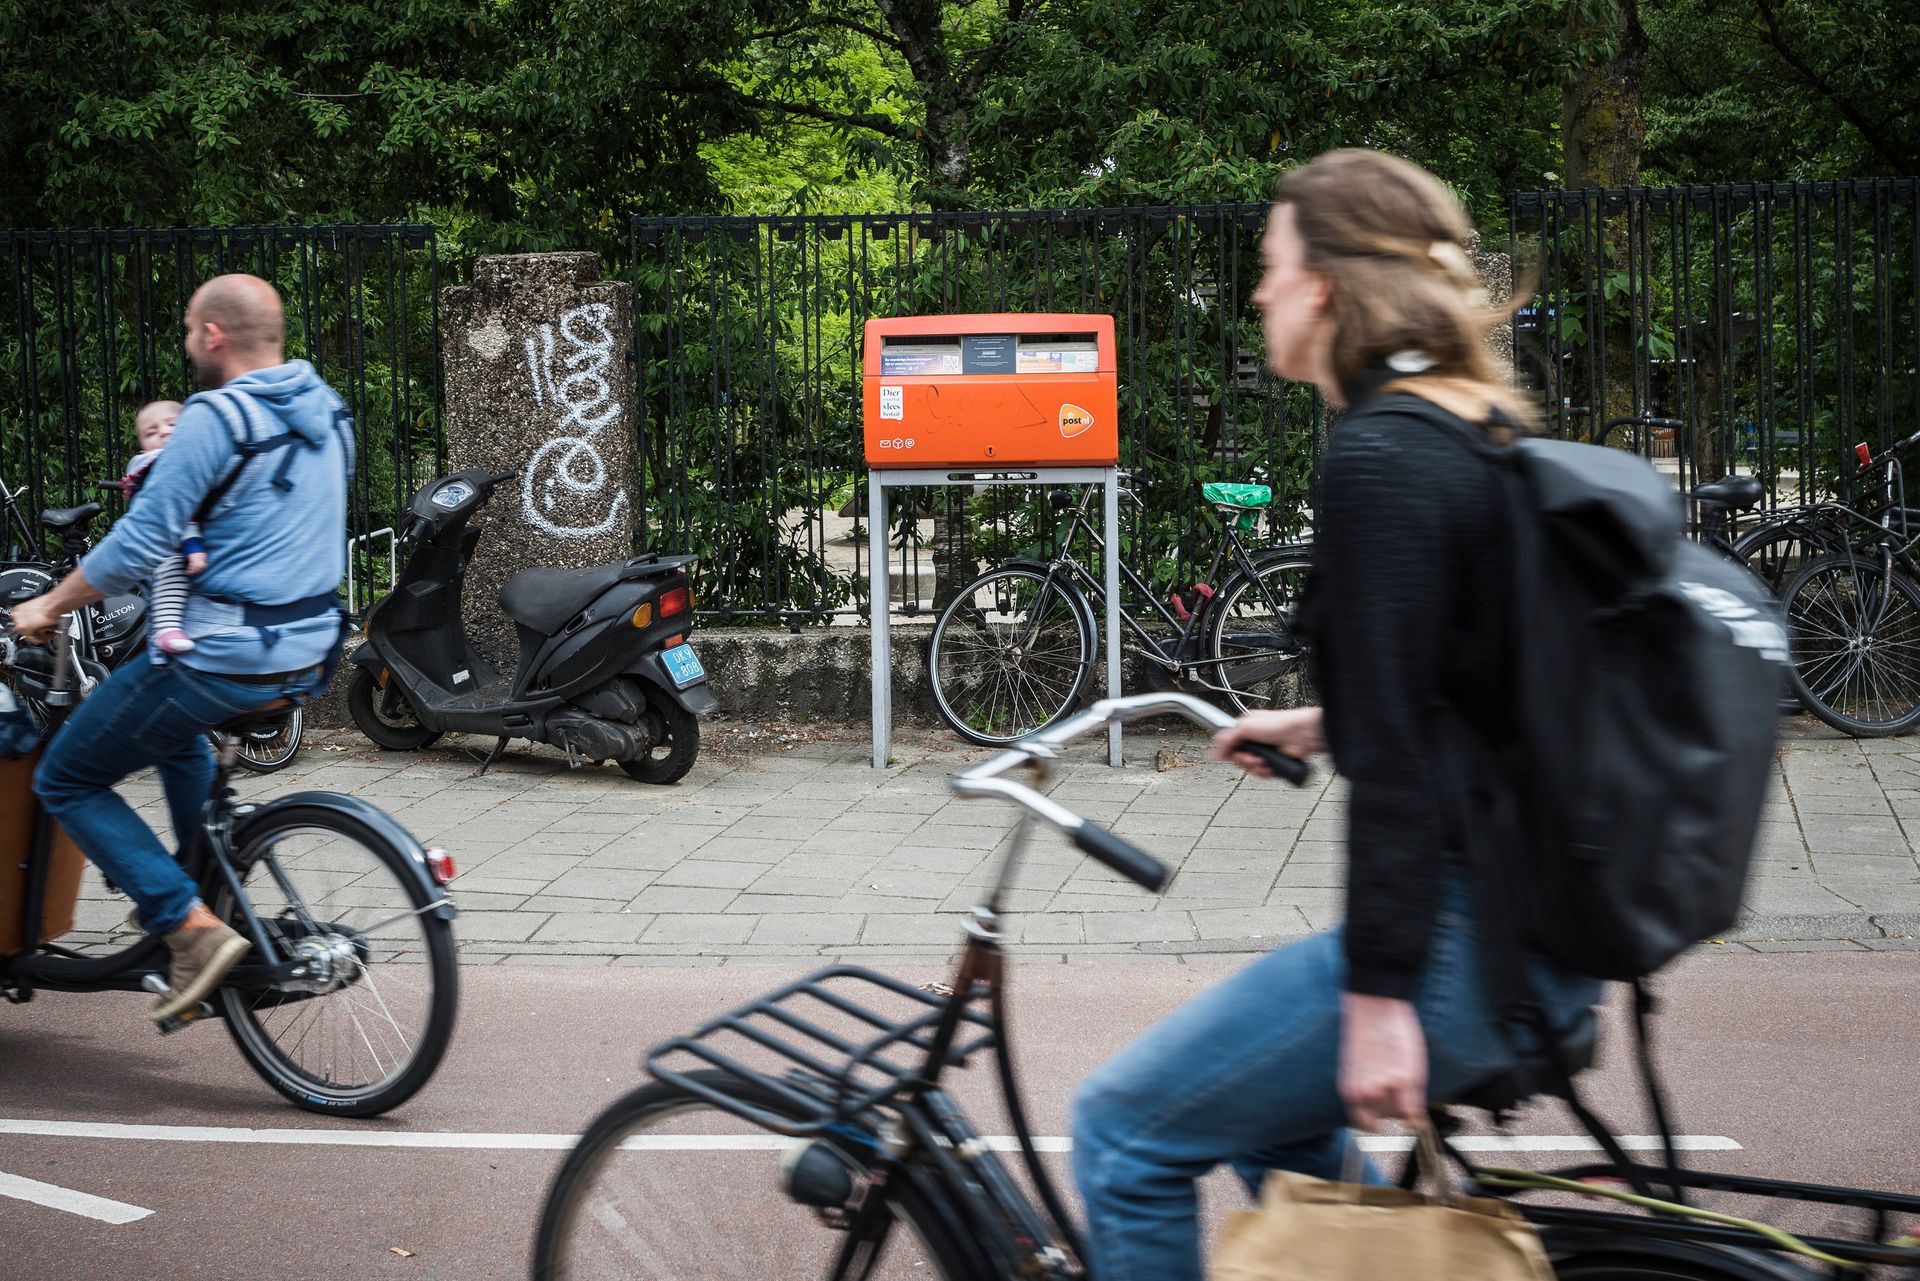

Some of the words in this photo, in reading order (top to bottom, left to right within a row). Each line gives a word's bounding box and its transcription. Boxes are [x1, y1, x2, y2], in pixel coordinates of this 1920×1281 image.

[882, 388, 901, 397] Dier
[882, 402, 901, 410] vlees
[1063, 416, 1090, 427] postnl
[96, 603, 136, 624] OULTON
[672, 648, 692, 664] DK9
